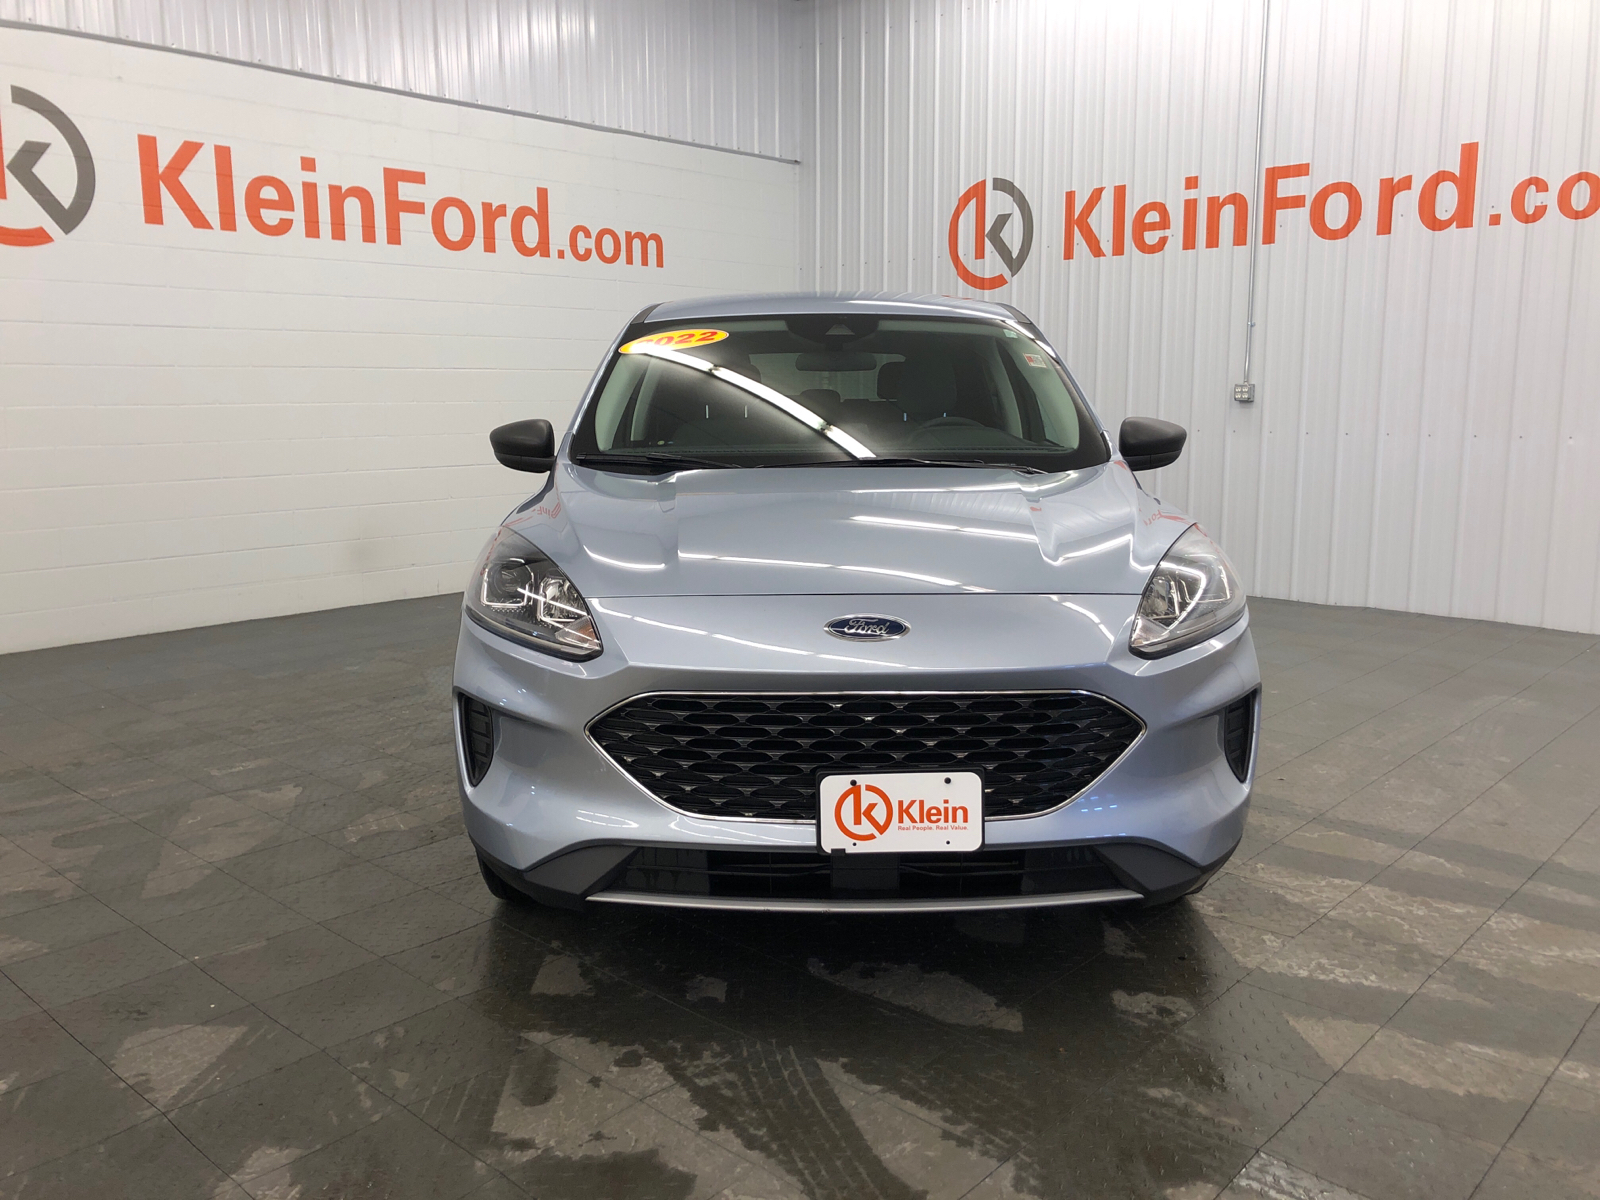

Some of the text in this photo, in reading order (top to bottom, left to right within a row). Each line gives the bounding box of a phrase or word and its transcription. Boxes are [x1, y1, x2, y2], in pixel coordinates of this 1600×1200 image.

[136, 133, 664, 268] KleinFord.com
[1063, 141, 1600, 260] KleinFord.co
[844, 618, 890, 635] Ford
[897, 799, 969, 824] Klein
